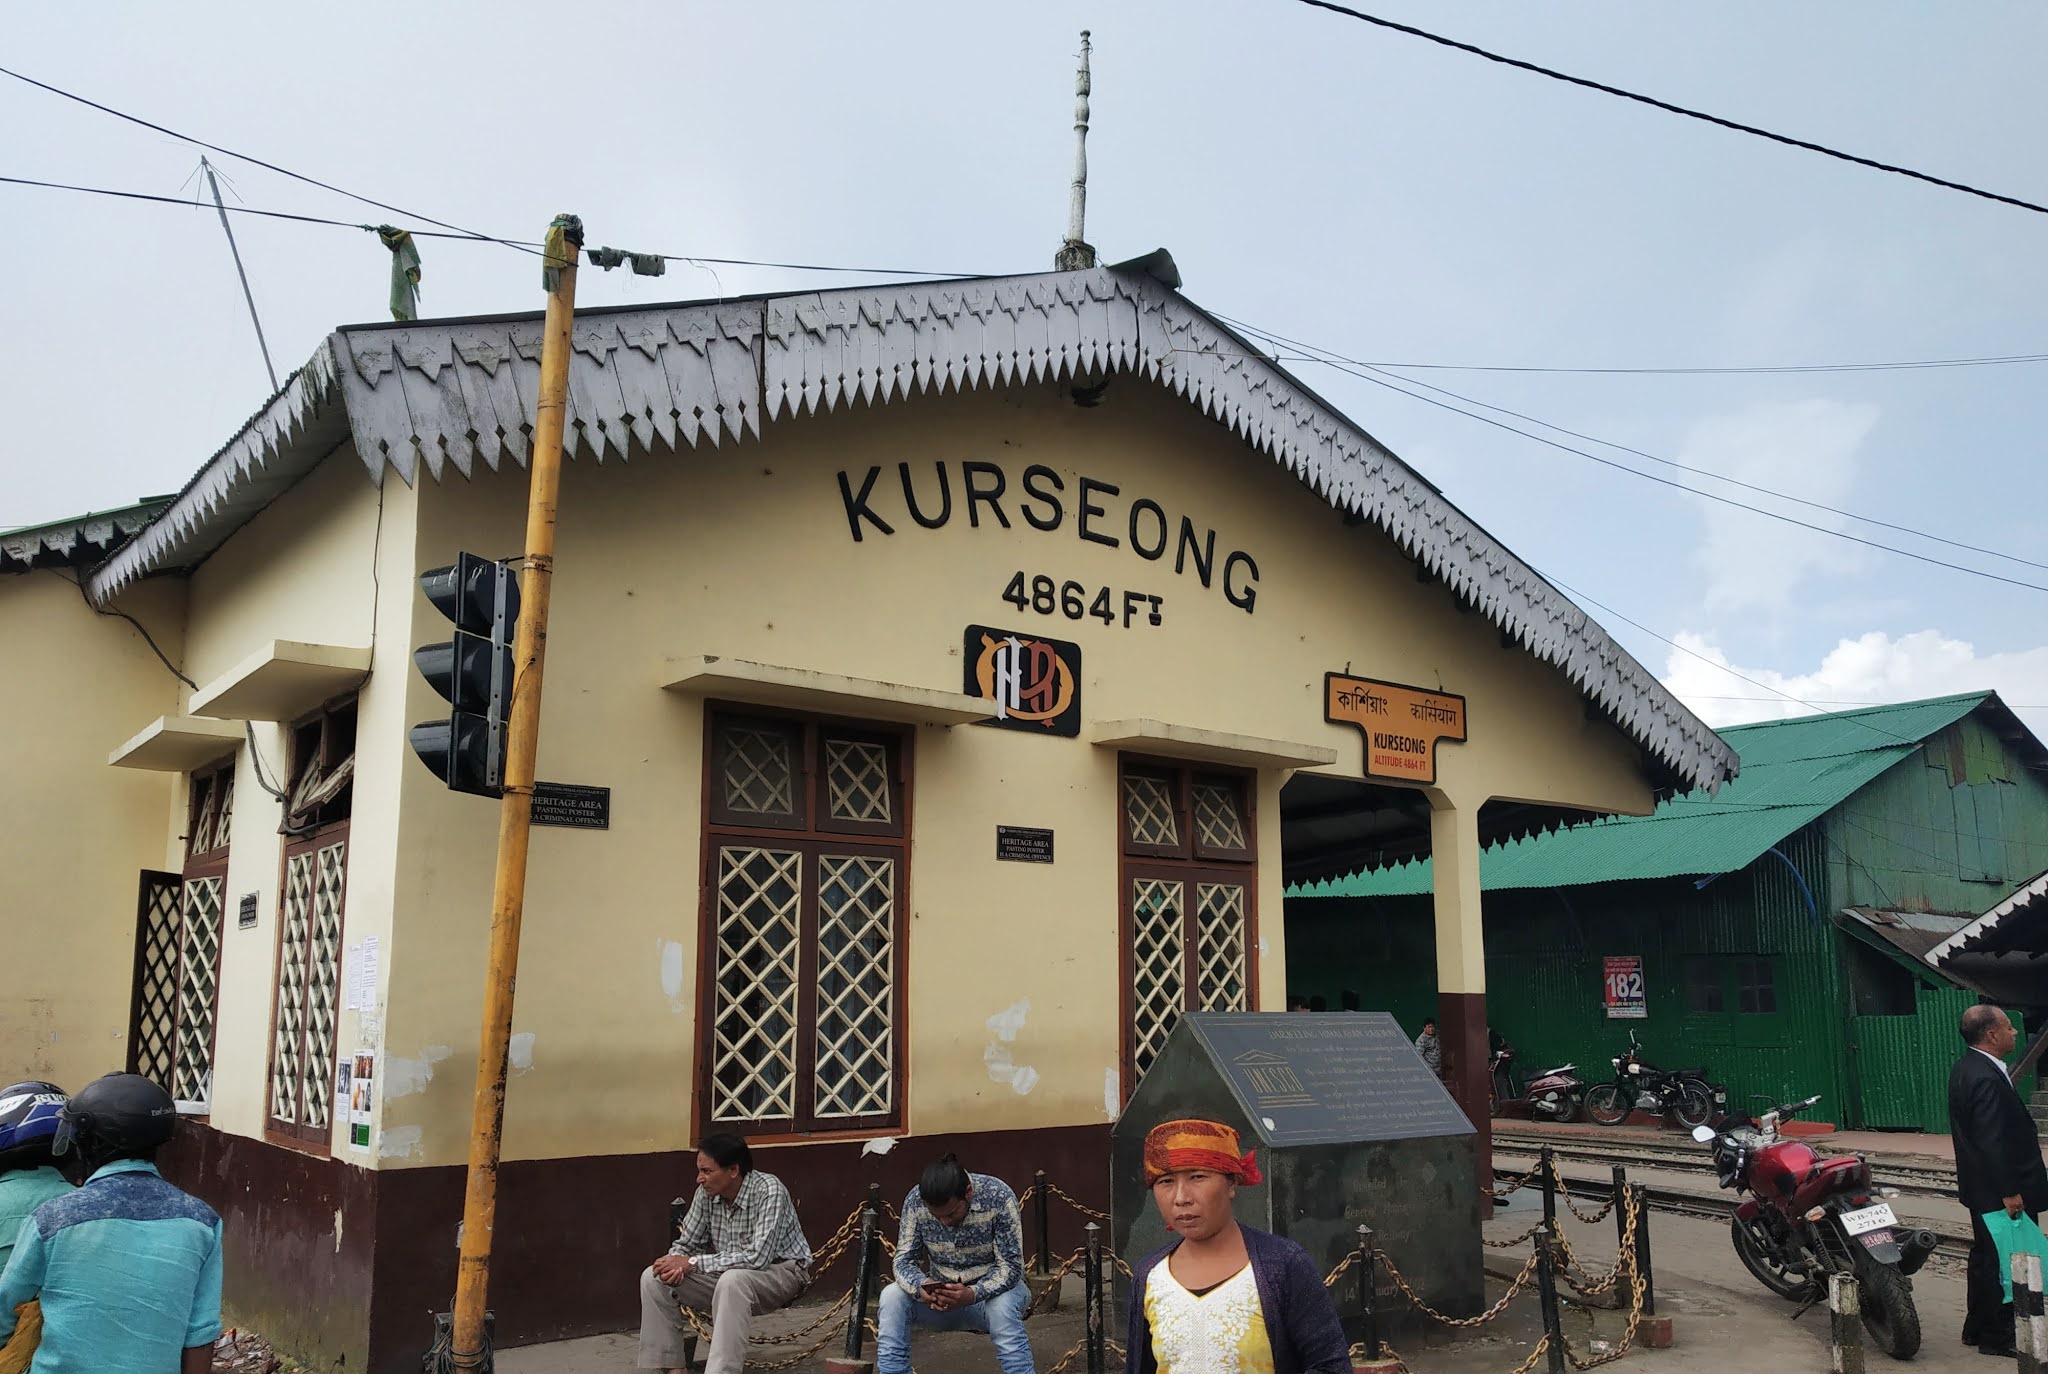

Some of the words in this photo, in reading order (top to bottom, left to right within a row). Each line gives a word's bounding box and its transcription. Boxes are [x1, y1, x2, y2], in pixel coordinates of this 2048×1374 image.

[838, 460, 1260, 614] KURSEONG
[1374, 732, 1426, 755] KURSEONG
[1374, 755, 1403, 768] ALTITUDE
[1403, 758, 1418, 770] 4864
[1419, 761, 1426, 771] FT
[531, 796, 577, 807] HERITAGE
[578, 801, 602, 809] AREA
[537, 806, 567, 815] PASTING
[568, 808, 595, 817] POSTER
[540, 815, 574, 823] CRIMINAL
[575, 817, 606, 825] OFFENCE
[1002, 838, 1032, 847] HERITAGE
[1033, 840, 1049, 848] AREA
[1607, 973, 1642, 998] 182
[1243, 1066, 1305, 1094] UNESCO
[1856, 1217, 1887, 1229] 2716
